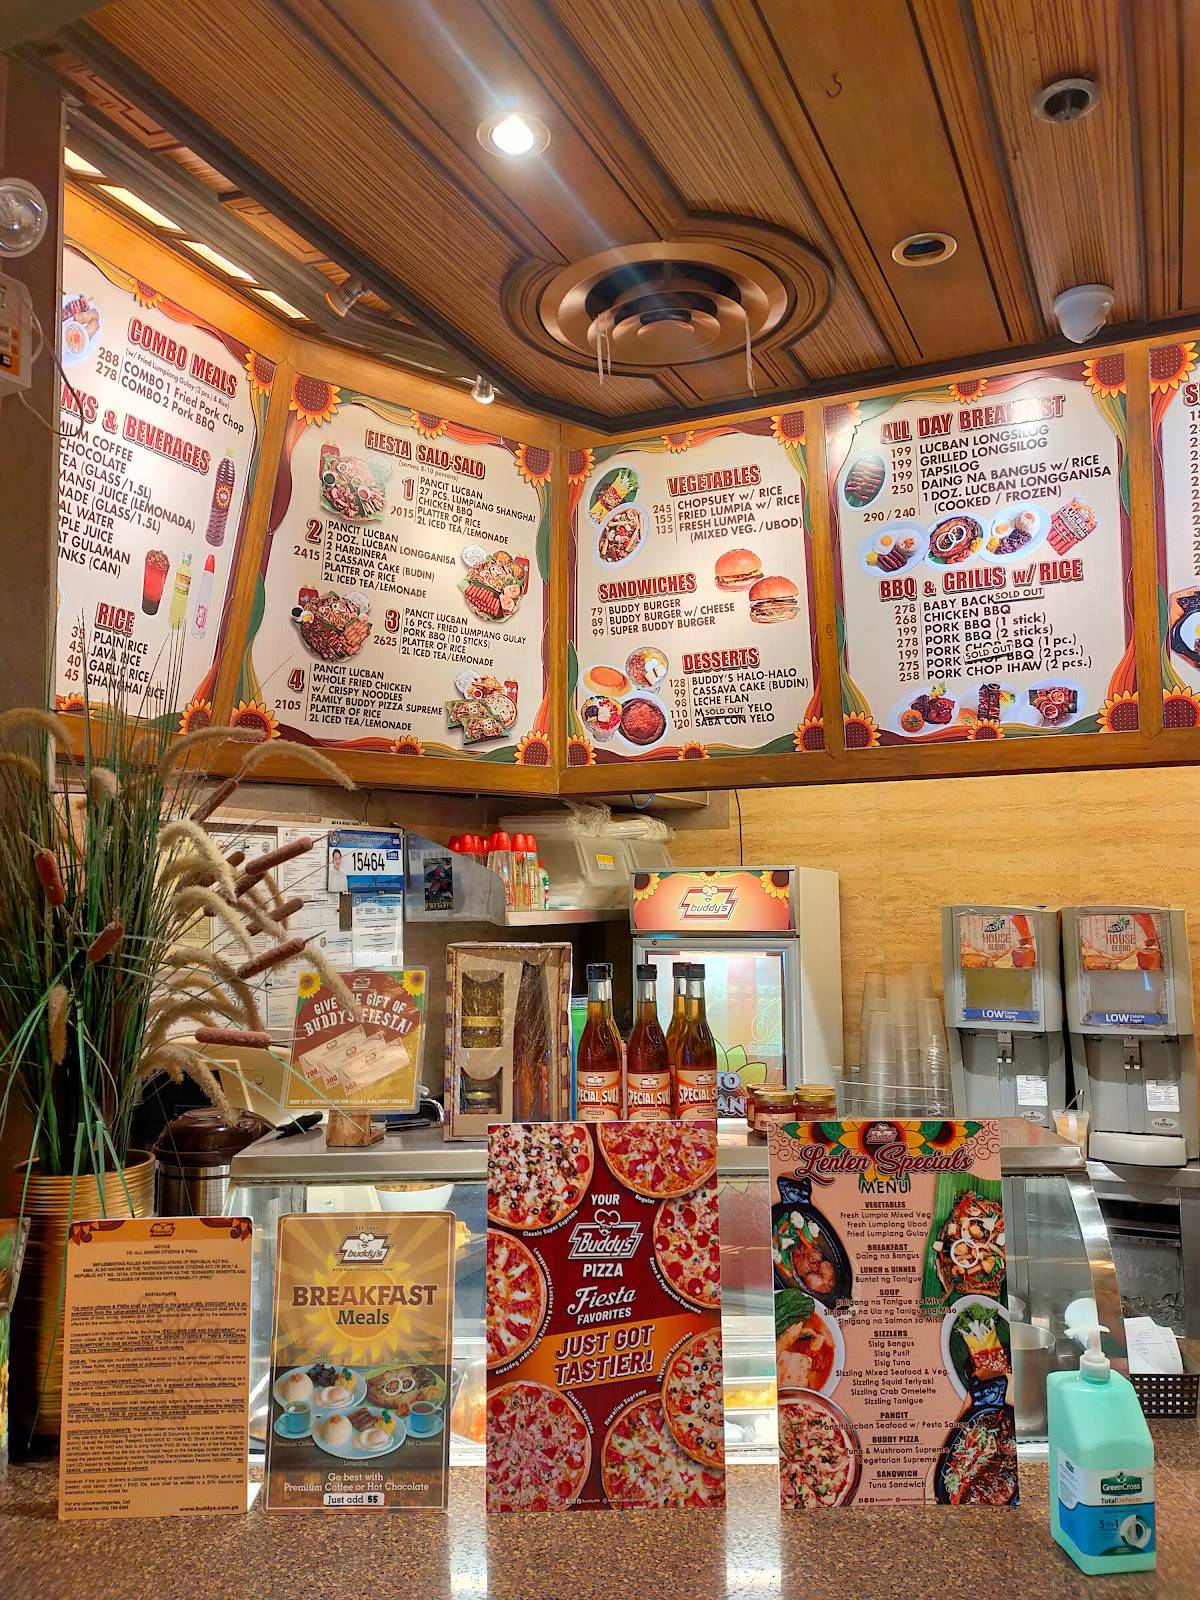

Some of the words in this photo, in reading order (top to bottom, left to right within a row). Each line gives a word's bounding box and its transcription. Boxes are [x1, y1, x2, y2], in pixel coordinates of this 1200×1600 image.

[129, 318, 187, 369] COMBO
[190, 351, 238, 398] MEALS
[96, 362, 117, 381] 278
[122, 376, 161, 403] COMBO
[162, 394, 169, 408] 2
[172, 400, 194, 423] Pork
[196, 412, 216, 432] BBQ
[99, 348, 119, 366] 288
[124, 362, 163, 391] COMBO
[166, 384, 170, 395] 1
[174, 388, 197, 408] Fried
[199, 402, 220, 421] Pork
[223, 414, 244, 433] Chop
[881, 423, 912, 443] ALL
[918, 413, 953, 439] DAY
[103, 409, 117, 433] &
[124, 414, 210, 474] BEVERAGES
[365, 429, 412, 460] FIESTA
[416, 444, 486, 479] SALO-SALO
[892, 459, 912, 471] 199
[920, 452, 968, 466] GRILLED
[972, 437, 1047, 457] LONGSILOG
[667, 465, 761, 496] VEGETABLES
[892, 484, 913, 495] 250
[922, 476, 963, 490] DAING
[967, 471, 987, 483] NA
[991, 463, 1046, 481] BANGUS
[1050, 458, 1069, 472] w/
[1072, 455, 1099, 468] RICE
[402, 478, 414, 500] 1
[420, 478, 449, 492] PANCIT
[451, 484, 483, 499] LUCBAN
[100, 484, 127, 505] JUICE
[131, 498, 196, 533] (LEMONADA)
[418, 497, 454, 512] CHICKEN
[457, 506, 473, 517] BBQ
[653, 505, 672, 514] 245
[678, 493, 735, 510] CHOPSUEY
[739, 489, 755, 500] w/
[759, 486, 782, 497] RICE
[655, 514, 673, 524] 155
[679, 509, 707, 521] FRIED
[711, 502, 752, 516] LUMPIA
[756, 498, 771, 509] w/
[776, 495, 800, 506] RICE
[934, 495, 991, 515] (COOKED
[995, 493, 1002, 506] /
[1005, 485, 1062, 505] FROZEN)
[391, 506, 414, 519] 2015
[418, 507, 450, 521] PLATTER
[452, 515, 463, 524] OF
[465, 518, 481, 528] RICE
[656, 525, 673, 534] 135
[679, 520, 711, 532] FRESH
[714, 513, 755, 527] LUMPIA
[72, 536, 130, 564] GULAMAN
[294, 546, 320, 560] 2415
[326, 552, 331, 560] 2
[334, 553, 375, 570] CASSAVA
[377, 560, 400, 573] CAKE
[402, 565, 435, 582] (BUDIN)
[599, 572, 697, 602] SANDWICHES
[879, 578, 918, 602] BBQ
[923, 582, 936, 597] &
[942, 567, 1006, 594] GRILLS
[1013, 564, 1037, 584] w/
[1039, 559, 1083, 583] RICE
[591, 607, 603, 616] 79
[609, 603, 640, 614] BUDDY
[643, 599, 681, 611] BURGER
[895, 615, 916, 625] 268
[924, 608, 978, 623] CHICKEN
[984, 604, 1011, 616] BBQ
[95, 602, 136, 635] RICE
[374, 635, 397, 647] 2625
[682, 647, 759, 674] DESSERTS
[899, 671, 919, 681] 258
[927, 667, 961, 680] PORK
[966, 664, 1002, 677] CHOP
[1007, 661, 1042, 672] IHAW
[1046, 659, 1058, 671] (2
[1062, 657, 1092, 670] pcs.)
[288, 667, 304, 692] 4
[314, 664, 347, 676] PANCIT
[349, 668, 384, 680] LUCBAN
[313, 674, 346, 687] WHOLE
[348, 678, 373, 690] FRIED
[376, 680, 411, 693] CHICKEN
[669, 679, 686, 688] 128
[692, 674, 734, 685] BUDDY'S
[737, 668, 797, 682] HALO-HALO
[275, 700, 301, 711] 2105
[311, 695, 343, 707] FAMILY
[346, 697, 376, 711] BUDDY
[379, 701, 404, 712] PIZZA
[406, 704, 442, 715] SUPREME
[675, 699, 687, 708] 98
[693, 696, 722, 707] LECHE
[725, 694, 749, 704] FLAN
[352, 852, 385, 871] 15464
[690, 903, 728, 914] buddy's
[983, 933, 1011, 944] HOUSE
[1106, 934, 1136, 944] HOUSE
[313, 997, 338, 1015] GIVE
[366, 993, 390, 1006] GIFT
[392, 1001, 407, 1013] OF
[982, 1009, 1005, 1018] LOW
[361, 1008, 412, 1034] FIESTA!
[1106, 1014, 1130, 1023] LOW
[680, 1085, 710, 1104] SPECIAL
[795, 1144, 871, 1188] Lenten
[876, 1142, 973, 1178] Specials
[861, 1181, 909, 1194] MENU
[591, 1194, 619, 1205] YOUR
[347, 1250, 382, 1259] buddy's
[579, 1232, 633, 1256] Buddy's
[583, 1263, 623, 1278] PIZZA
[292, 1285, 438, 1306] BREAKFAST
[567, 1286, 636, 1315] Fiesta
[336, 1309, 389, 1325] Meals
[577, 1307, 632, 1325] FAVORITES
[556, 1332, 609, 1359] JUST
[614, 1324, 655, 1349] GOT
[554, 1352, 654, 1387] TASTIER!
[284, 1483, 322, 1492] Premium
[325, 1483, 353, 1491] Coffee
[368, 1483, 382, 1491] Hot
[385, 1483, 429, 1491] Chocolate
[328, 1473, 341, 1481] Go
[344, 1473, 362, 1481] best
[1103, 1483, 1140, 1491] GreenCross
[328, 1495, 345, 1504] just
